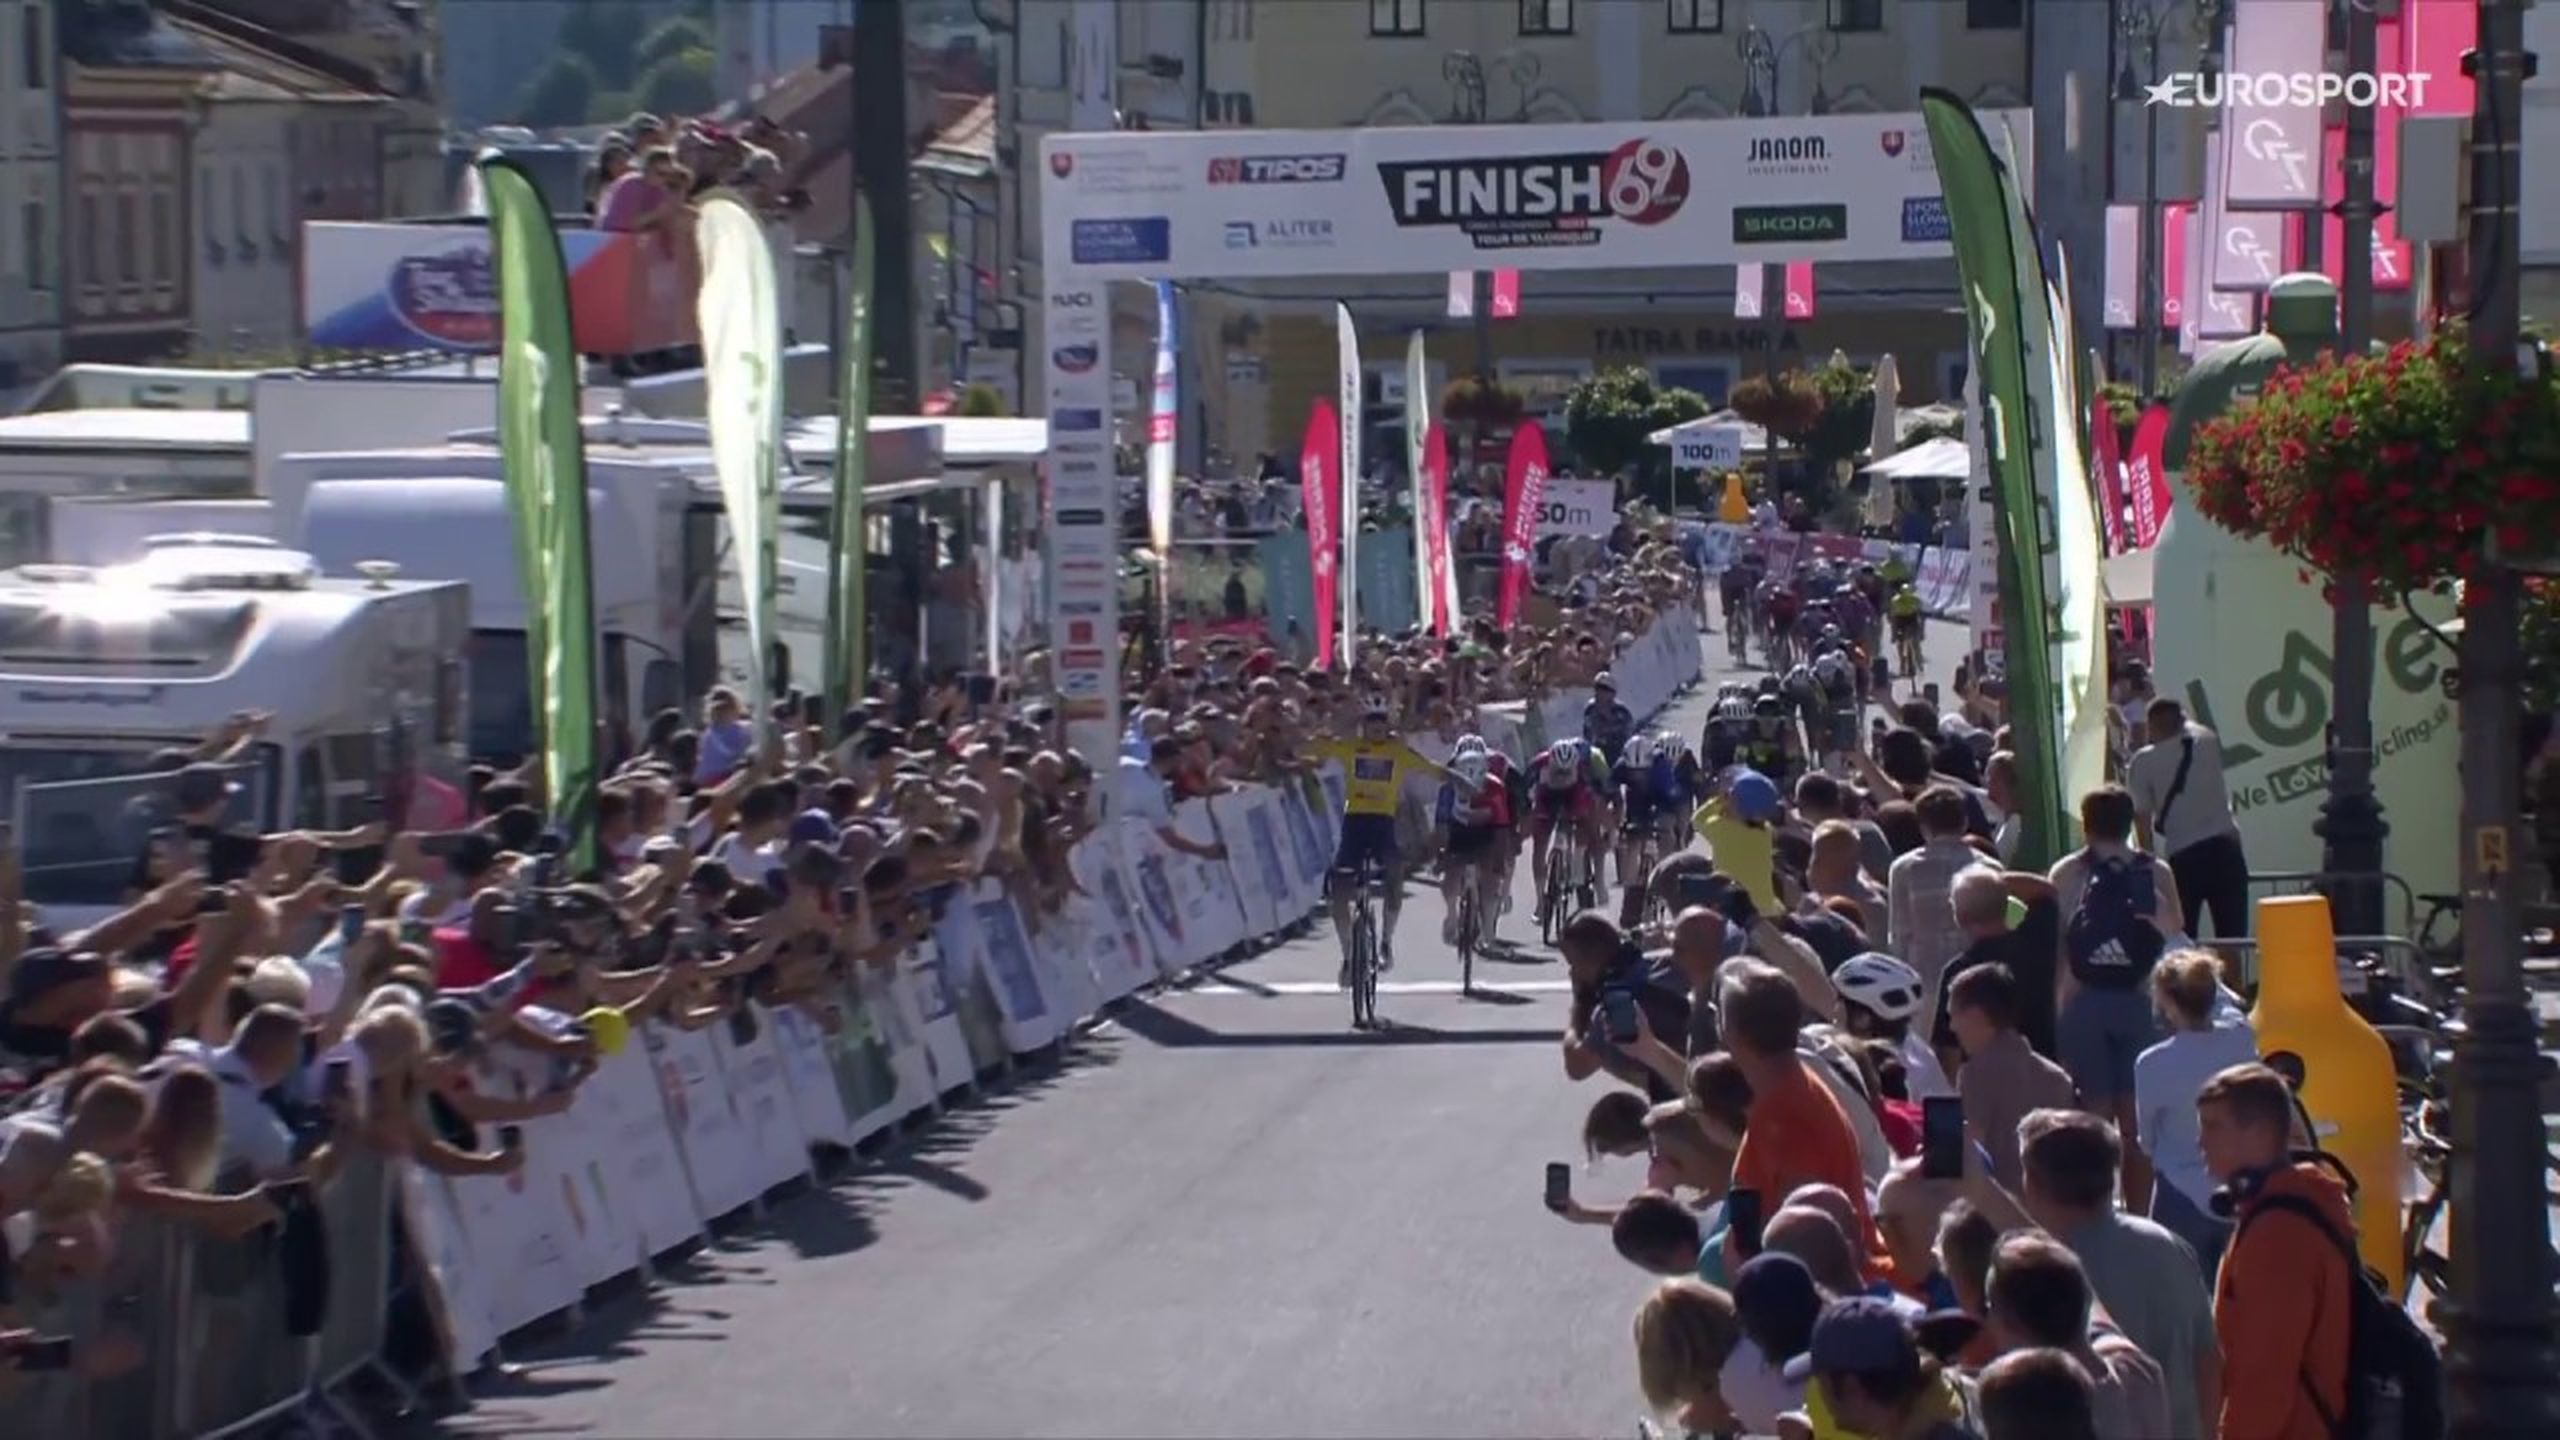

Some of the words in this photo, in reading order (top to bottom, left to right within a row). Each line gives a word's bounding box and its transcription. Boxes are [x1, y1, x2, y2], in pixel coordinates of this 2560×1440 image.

[1246, 157, 1340, 179] TIPOS
[1403, 164, 1602, 216] FINISH
[1608, 140, 1676, 216] 69
[1267, 219, 1333, 236] ALITER
[1595, 328, 1685, 351] TATRA
